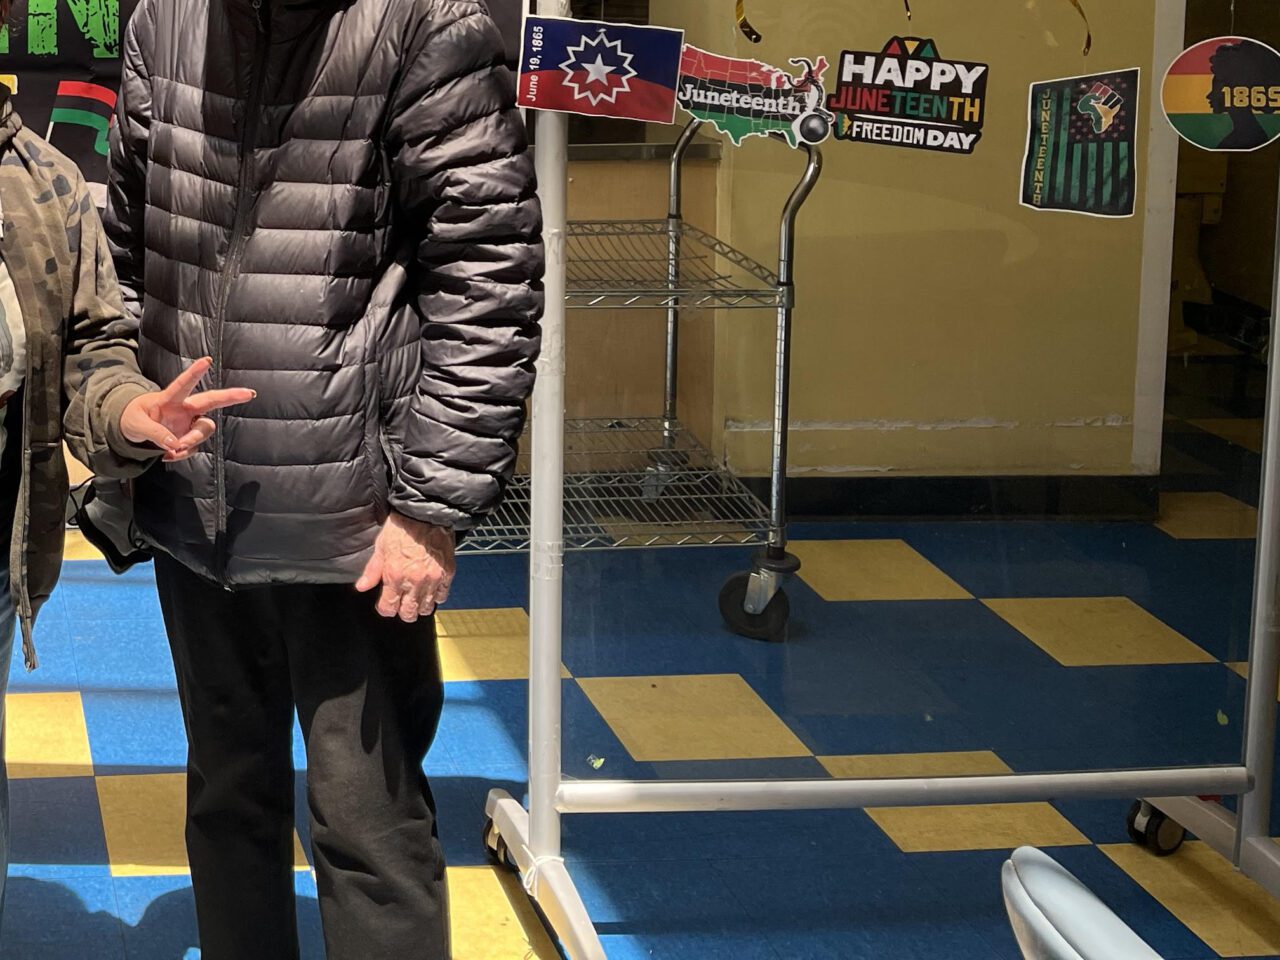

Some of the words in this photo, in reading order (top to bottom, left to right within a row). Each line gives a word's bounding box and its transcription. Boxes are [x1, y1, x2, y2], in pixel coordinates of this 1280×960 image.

[531, 26, 544, 52] 1865
[529, 55, 543, 70] 19,
[841, 53, 986, 94] HAPPY
[526, 75, 539, 102] June
[678, 83, 802, 115] Juneteenth
[1221, 86, 1280, 108] 1865
[830, 86, 981, 123] JUNETEENTH
[852, 120, 925, 145] FREEDOM
[926, 129, 977, 150] DAY
[1032, 88, 1051, 205] JUNETEENTH
